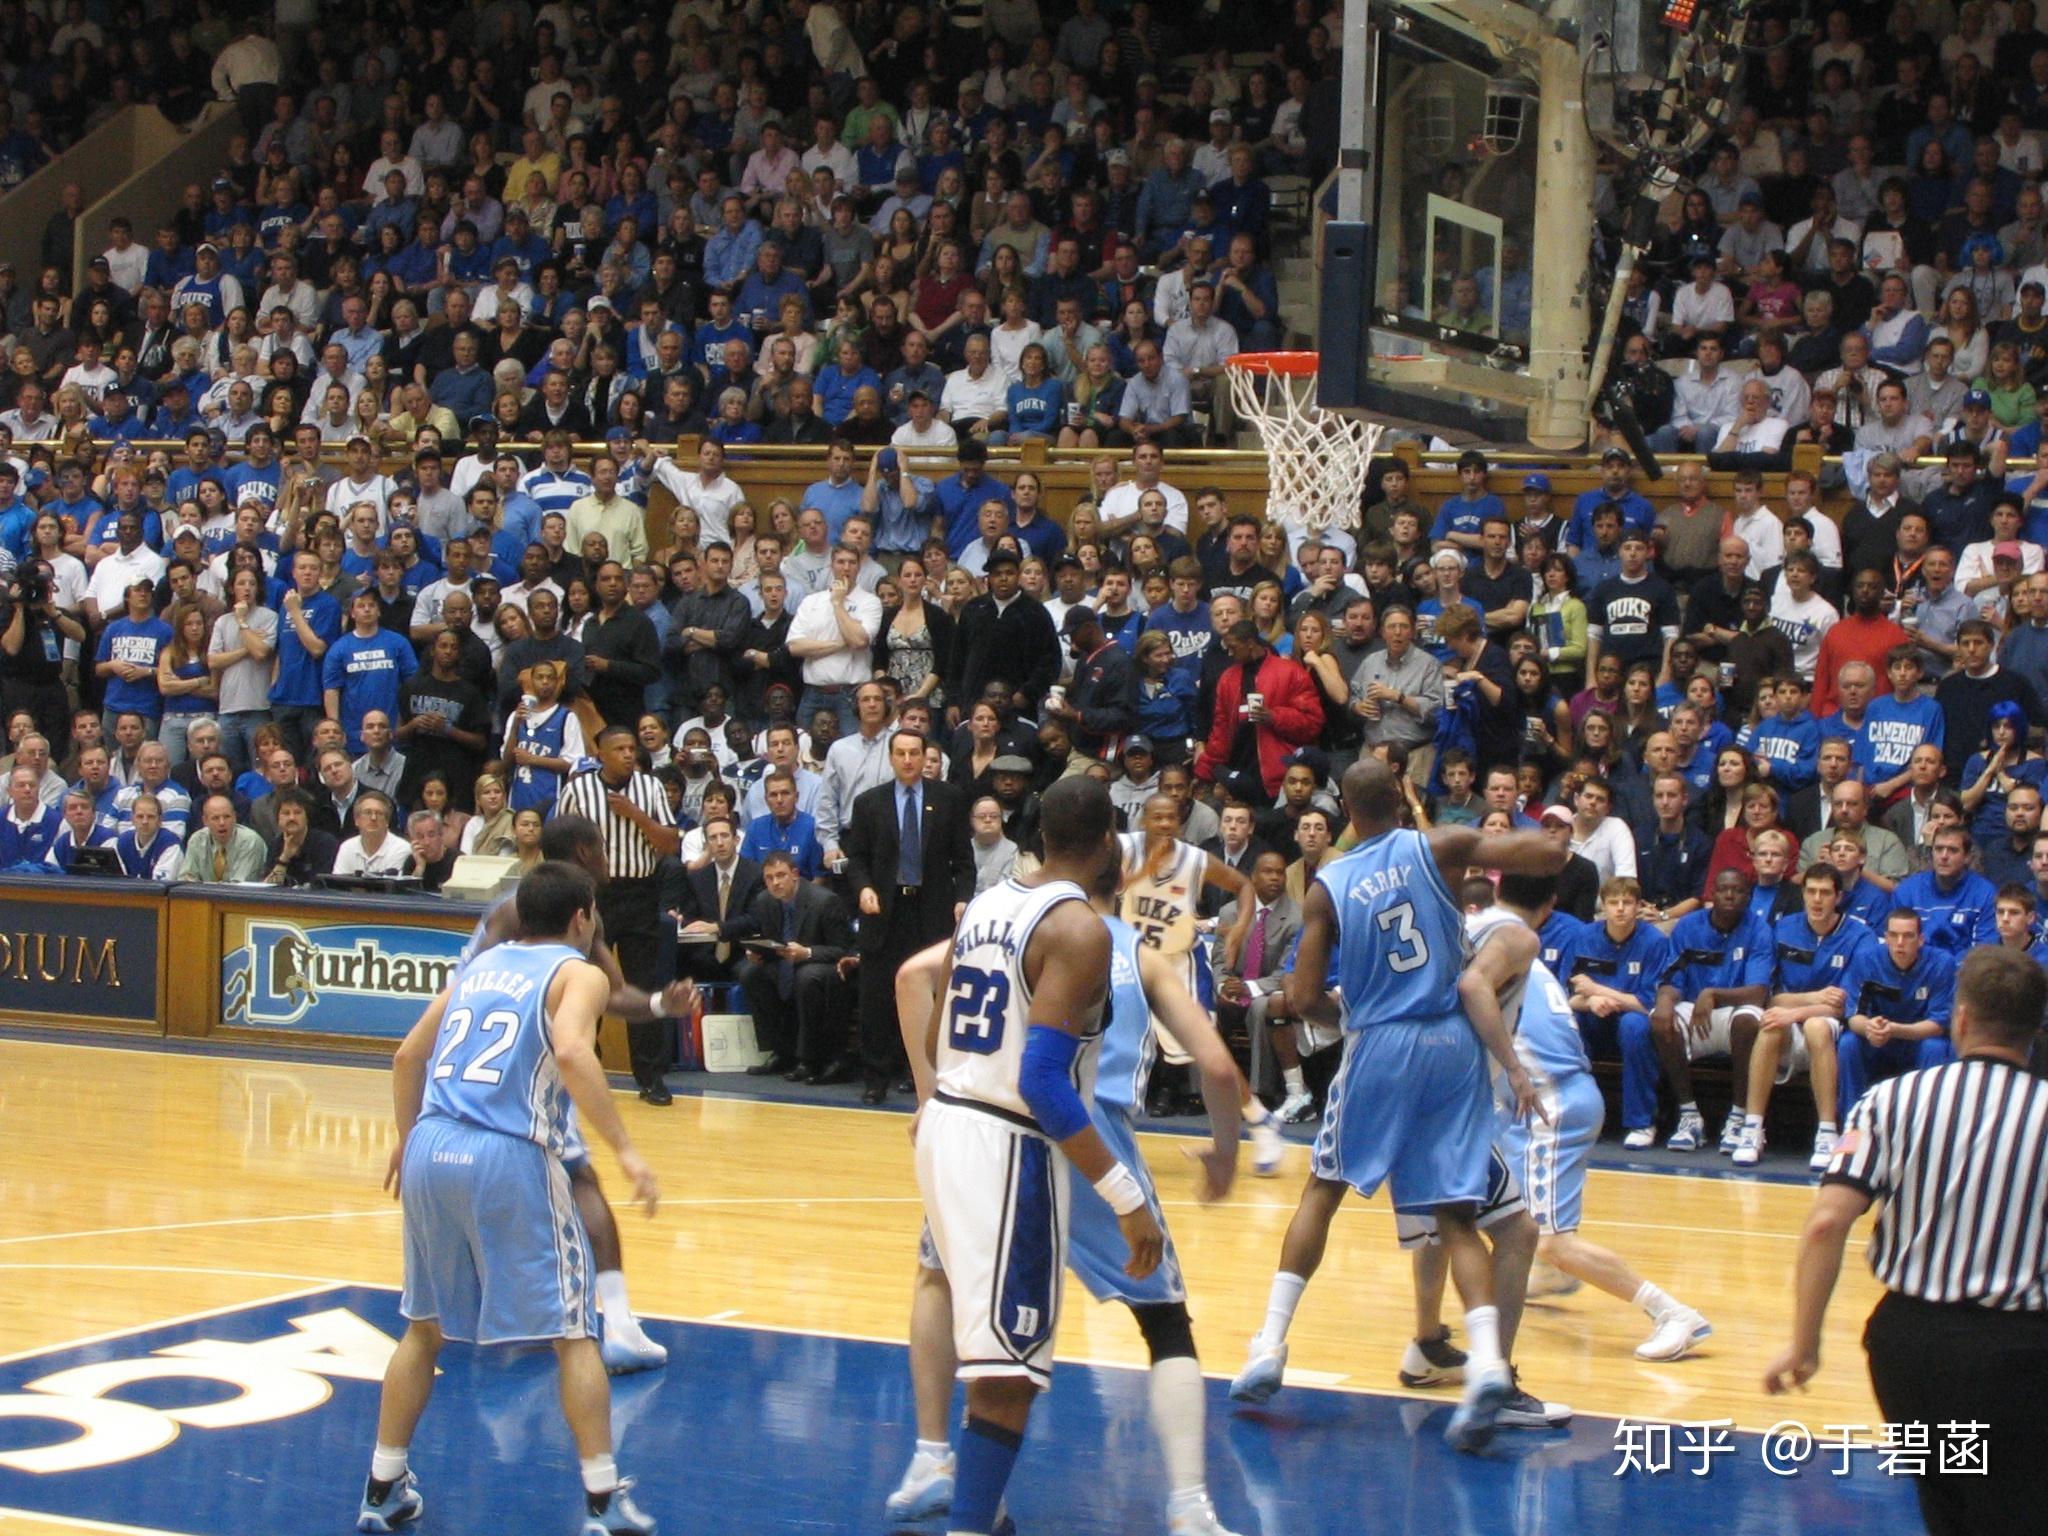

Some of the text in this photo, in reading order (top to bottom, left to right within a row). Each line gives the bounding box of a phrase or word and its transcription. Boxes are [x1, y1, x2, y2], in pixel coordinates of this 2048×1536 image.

[1016, 397, 1047, 413] DUKE
[237, 481, 277, 508] DUKE
[1606, 597, 1651, 624] DUKE
[111, 636, 157, 649] CAMERON
[1869, 721, 1925, 745] CAMERON
[1758, 737, 1799, 764] DUKE
[1348, 865, 1413, 906] TERRY
[1376, 901, 1430, 974] 3
[459, 969, 534, 1002] MILLER
[949, 964, 1010, 1056] 23
[433, 1008, 521, 1087] 22
